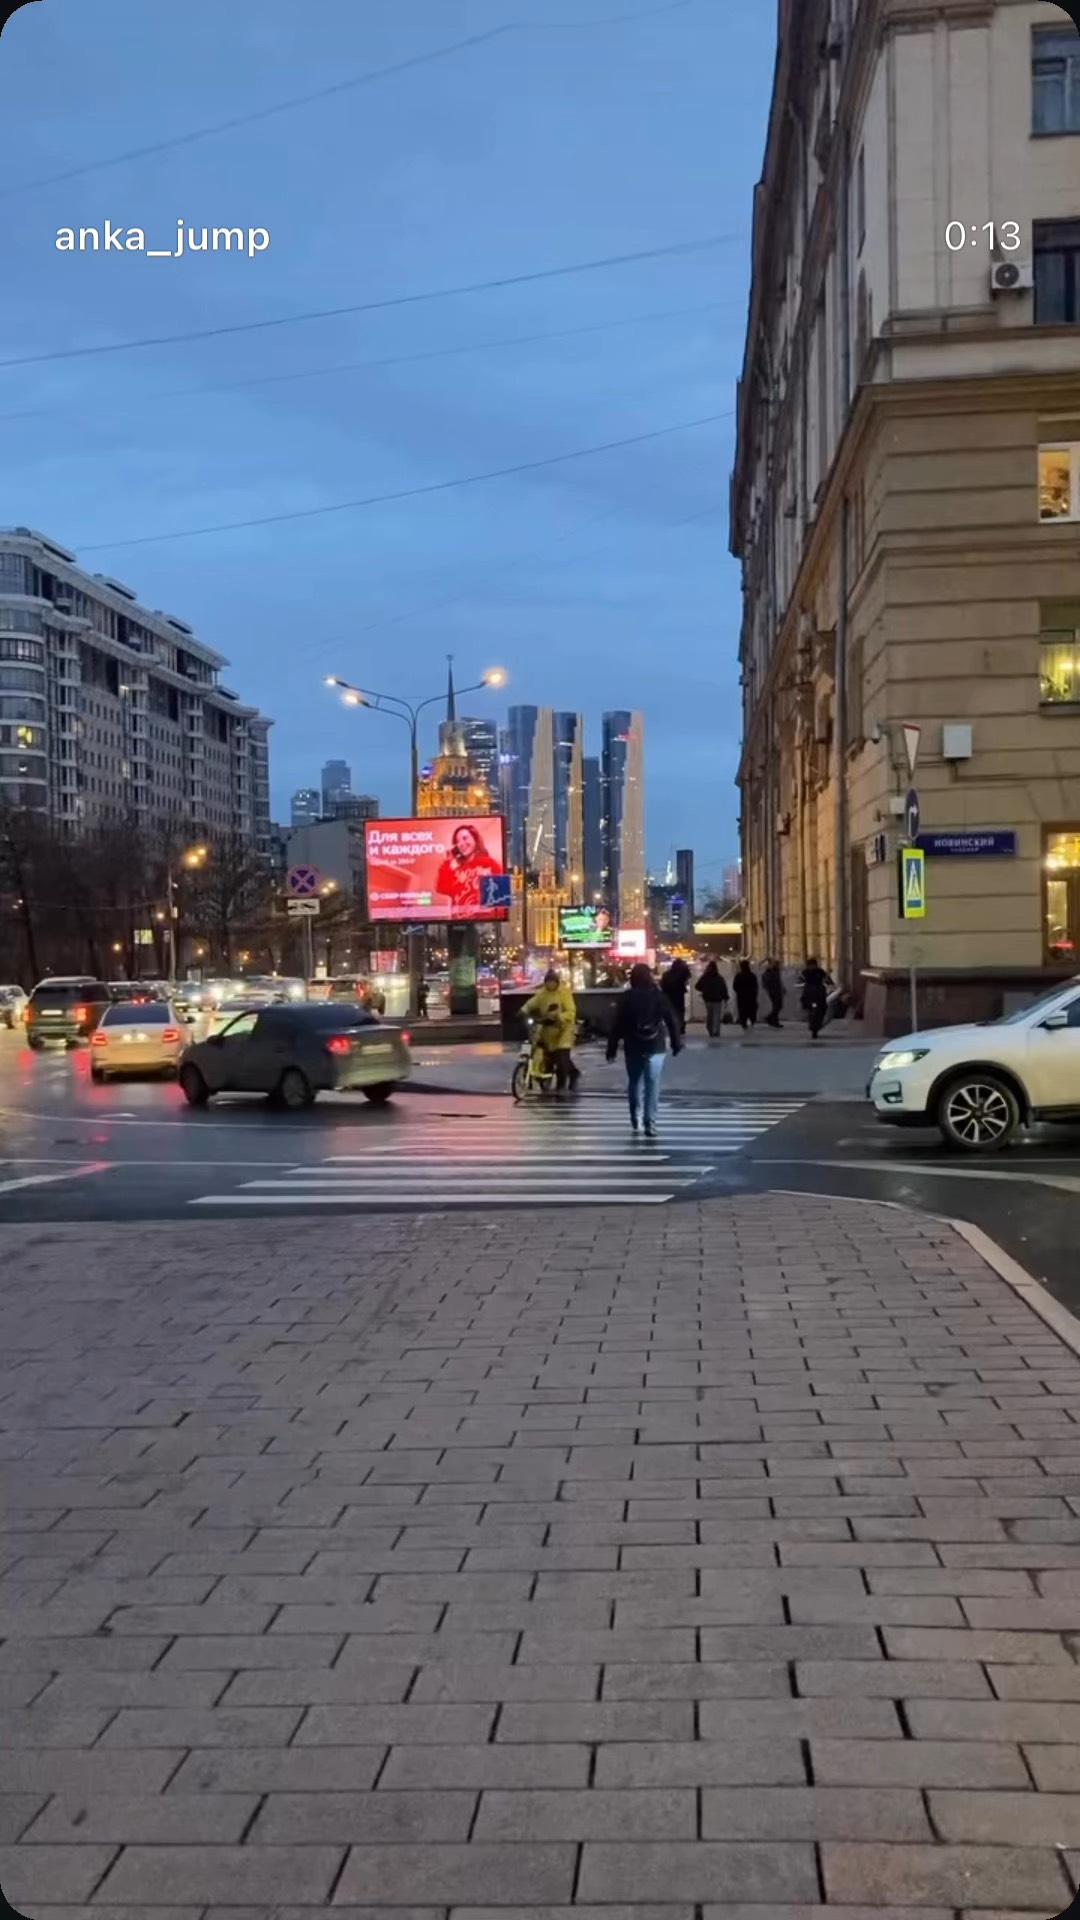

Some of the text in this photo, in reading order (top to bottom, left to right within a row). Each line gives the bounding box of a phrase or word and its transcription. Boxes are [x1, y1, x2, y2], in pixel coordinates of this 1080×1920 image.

[368, 830, 433, 844] Для всех
[934, 836, 994, 847] НОВИНСКИЙ
[369, 843, 445, 856] и каждого
